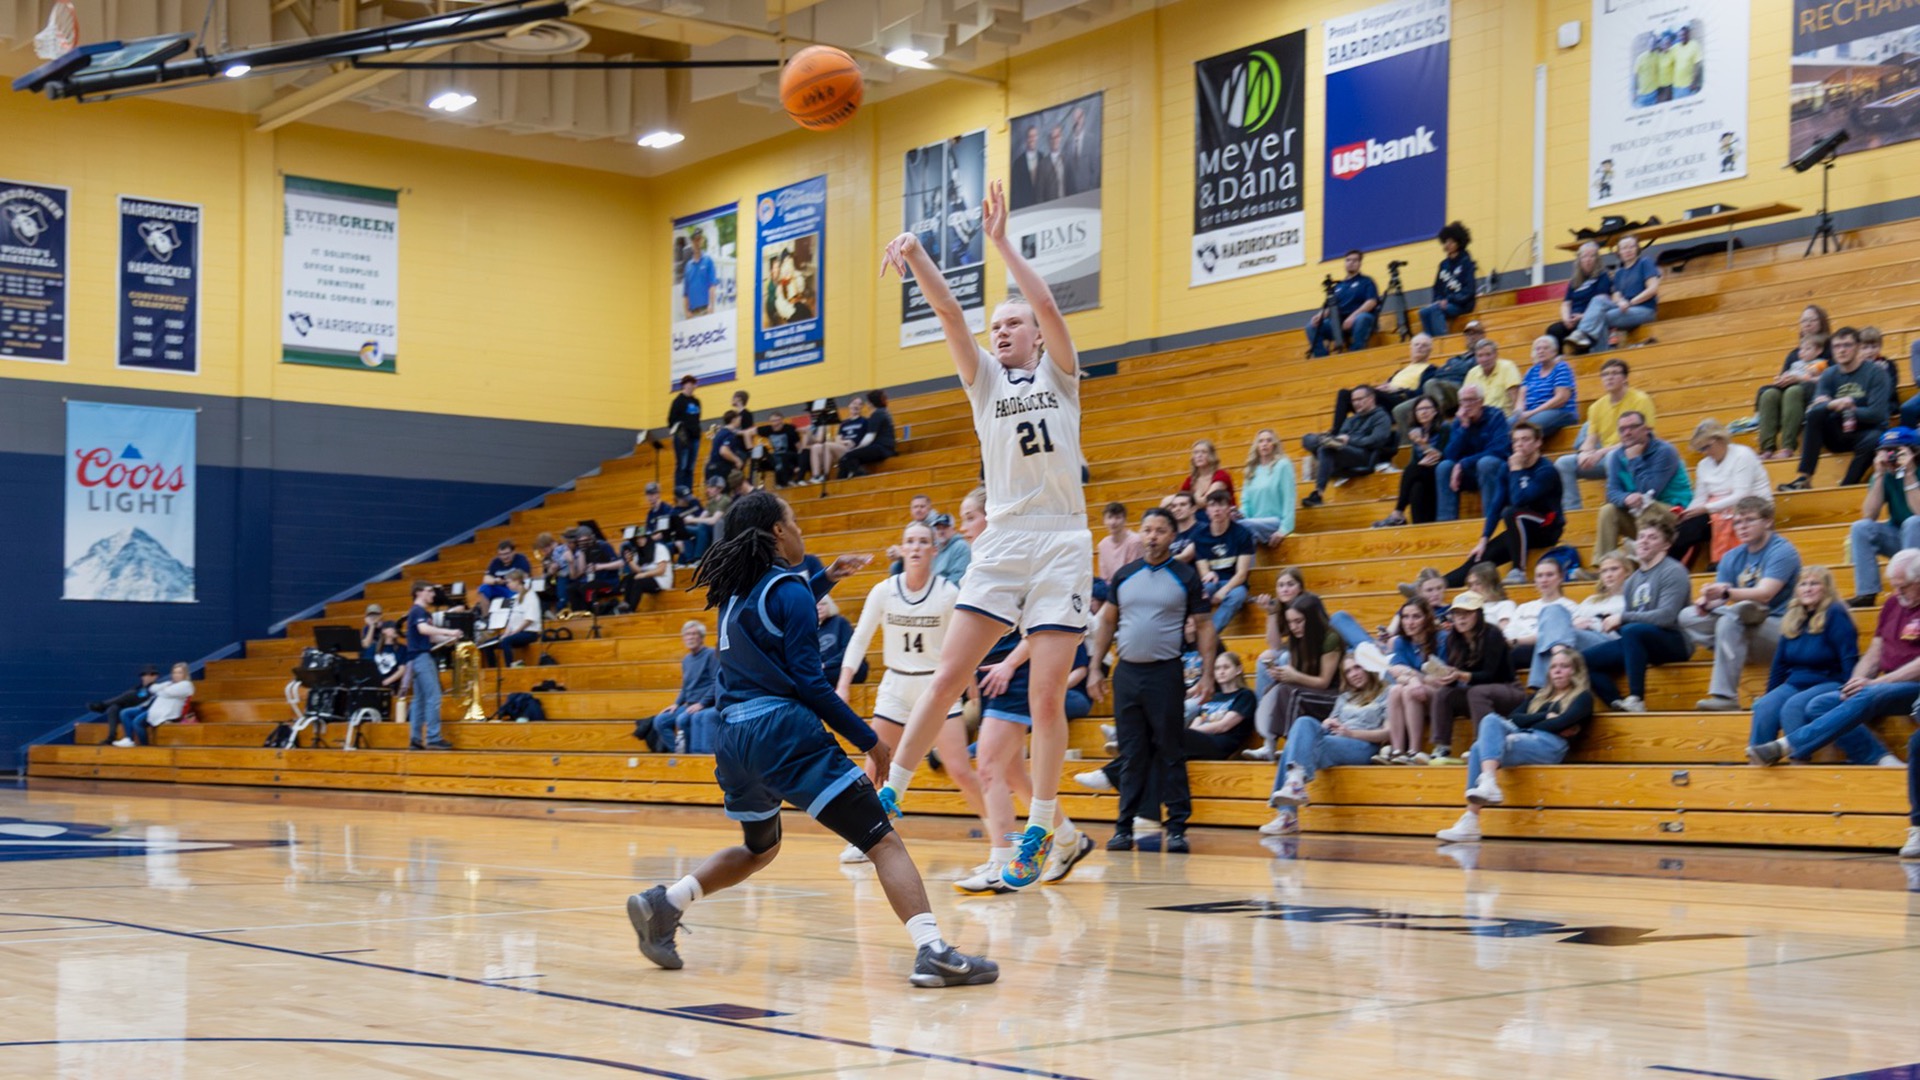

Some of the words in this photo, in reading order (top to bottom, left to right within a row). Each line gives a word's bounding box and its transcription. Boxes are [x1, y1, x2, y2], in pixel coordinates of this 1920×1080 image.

[1799, 0, 1920, 36] RECHA
[1199, 127, 1297, 178] Meyer
[295, 208, 395, 233] EVERGREEN
[1200, 196, 1298, 227] orthodontics
[1040, 220, 1087, 251] BMS
[323, 249, 371, 262] SOLUTIONS
[303, 262, 334, 273] OFFICE
[339, 266, 379, 278] SUPPLIES
[317, 278, 365, 290] FURNITURE
[330, 294, 367, 304] COPIERS
[317, 318, 394, 337] HARDROCKERS
[1016, 418, 1054, 457] 21
[74, 447, 187, 492] Coors
[88, 490, 175, 515] LIGHT
[903, 632, 924, 653] 14
